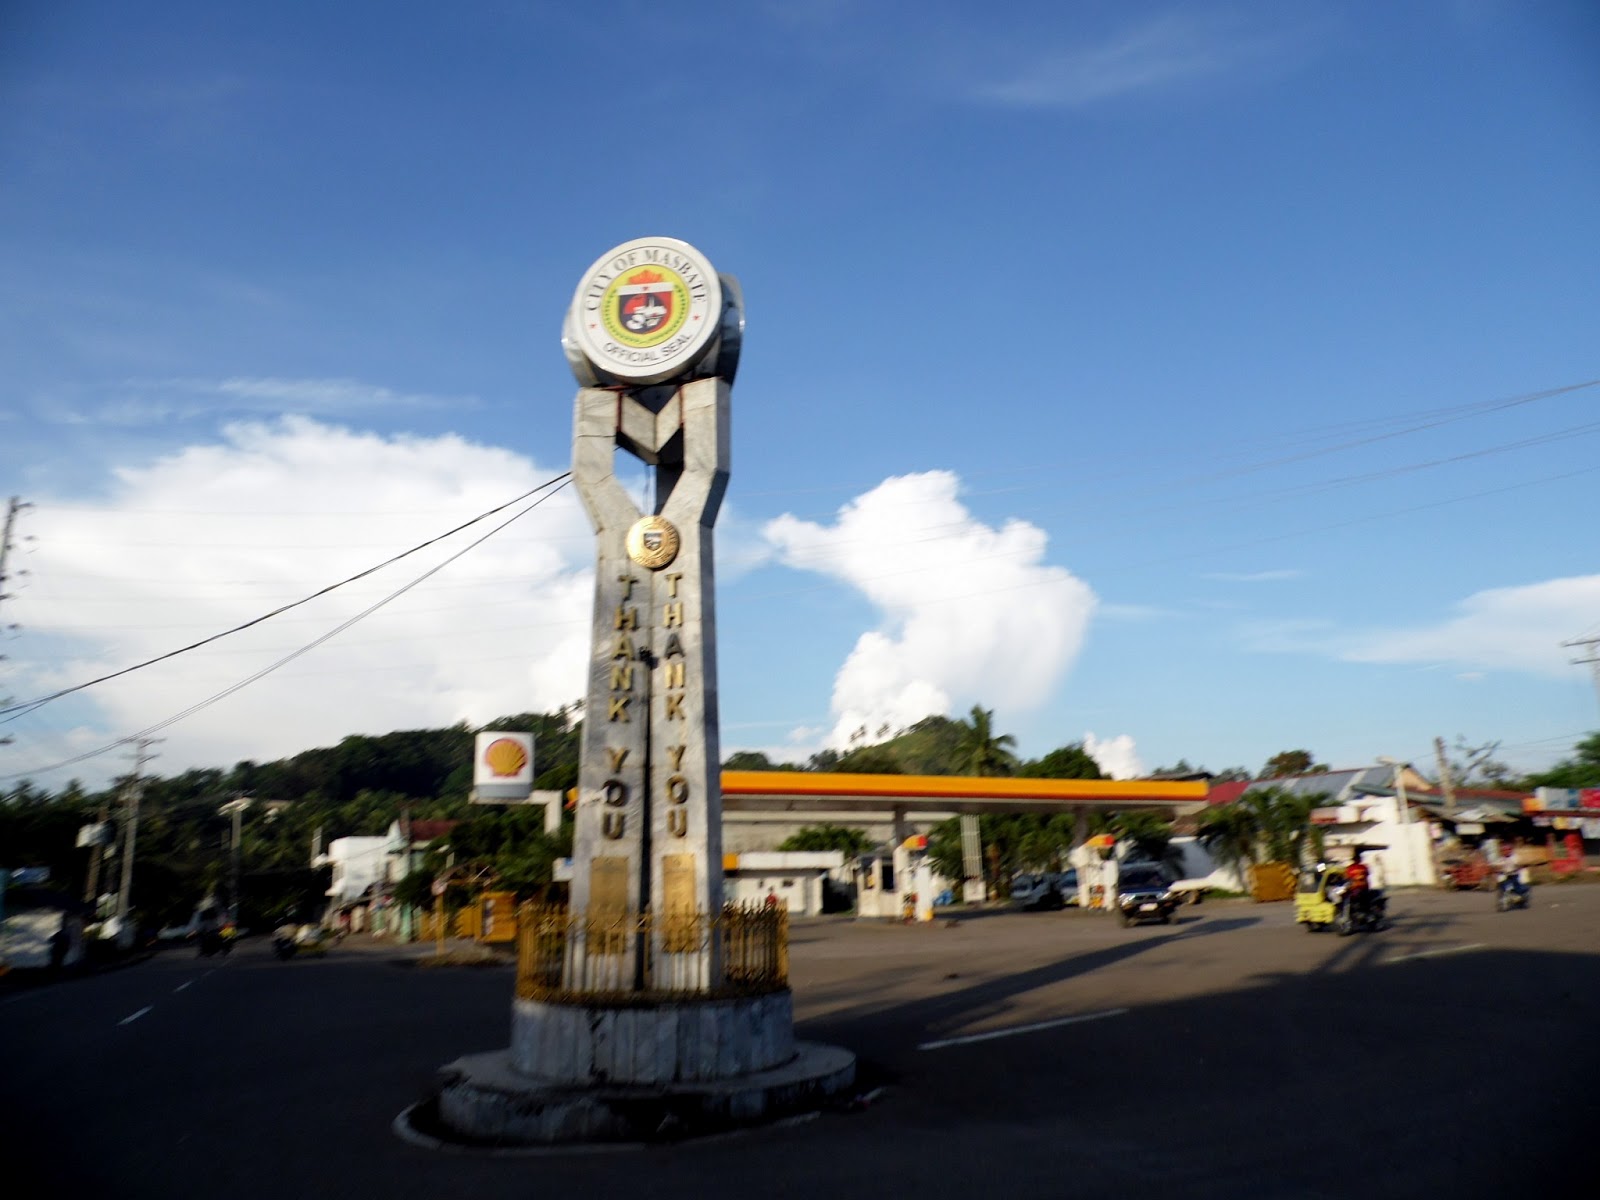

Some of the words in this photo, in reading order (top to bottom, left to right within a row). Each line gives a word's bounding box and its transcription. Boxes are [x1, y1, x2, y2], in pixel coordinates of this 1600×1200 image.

[587, 274, 613, 312] CITY
[613, 252, 637, 271] OF
[645, 249, 707, 303] MASBATE
[602, 342, 659, 363] OFFICIAL
[661, 333, 692, 357] SEAL
[608, 575, 639, 724] THANK
[662, 573, 686, 720] THANK
[601, 747, 630, 841] YOU
[665, 745, 689, 838] YOU
